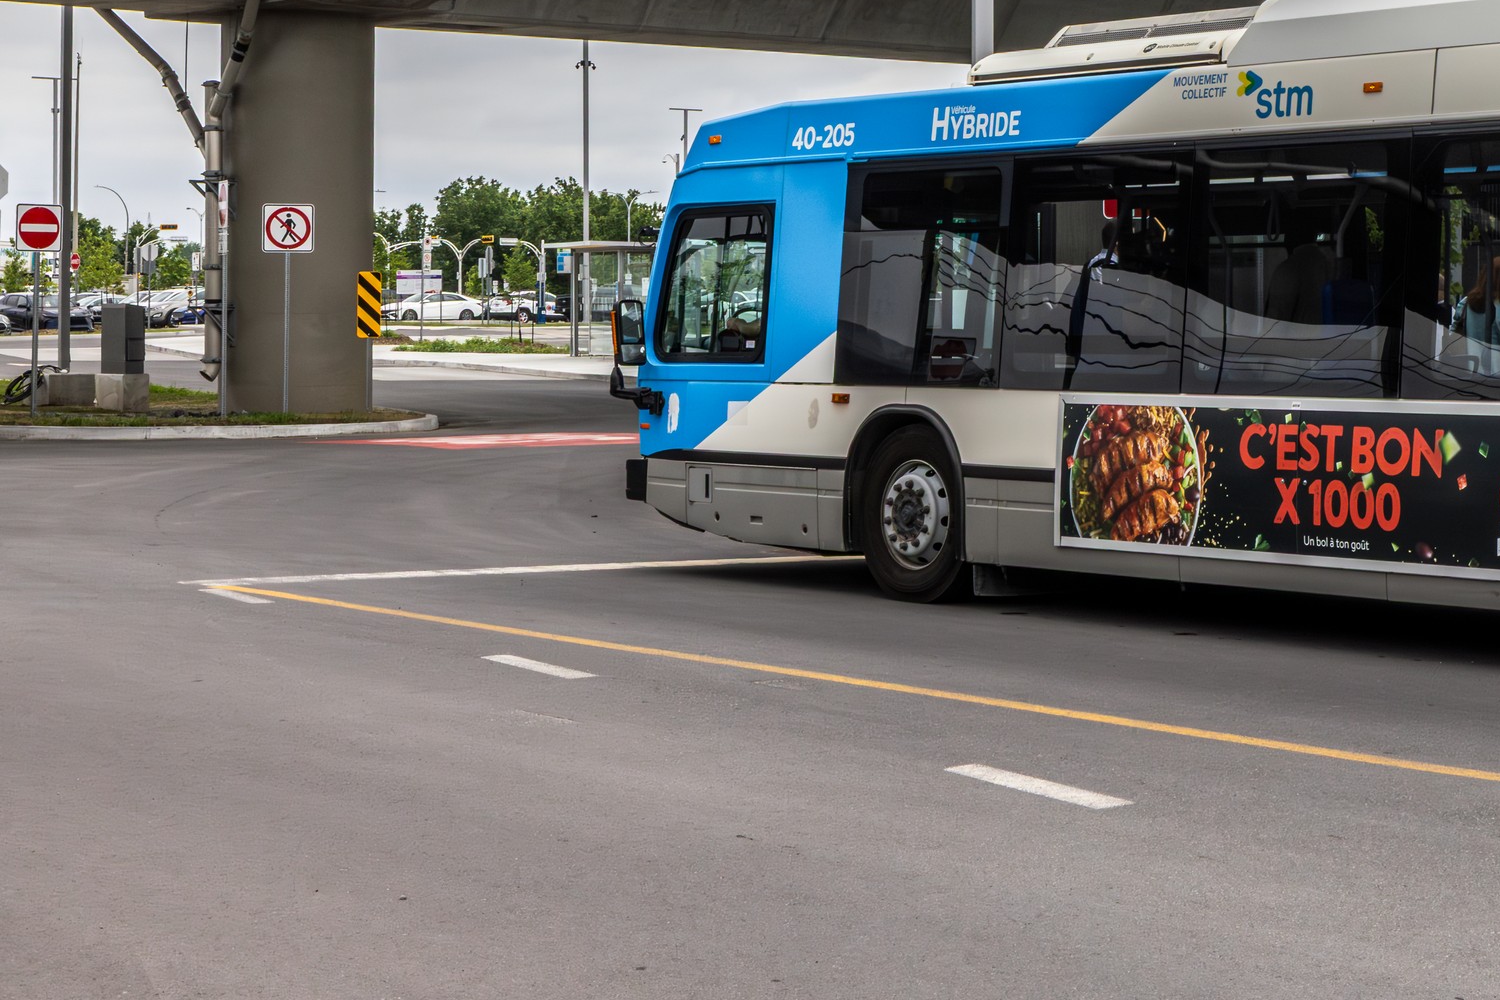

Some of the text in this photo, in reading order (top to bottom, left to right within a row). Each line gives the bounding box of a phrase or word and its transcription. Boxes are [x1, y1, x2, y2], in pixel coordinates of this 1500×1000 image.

[1173, 73, 1228, 87] MOUVEMENT
[1182, 86, 1227, 100] COLLECTIF
[1255, 80, 1313, 119] stm
[792, 122, 856, 151] 40-205
[931, 106, 1021, 142] HYBRIDE
[1239, 423, 1445, 479] C'EST BON
[1273, 477, 1401, 532] X 1000
[1303, 535, 1370, 552] Un bol à ton goût
